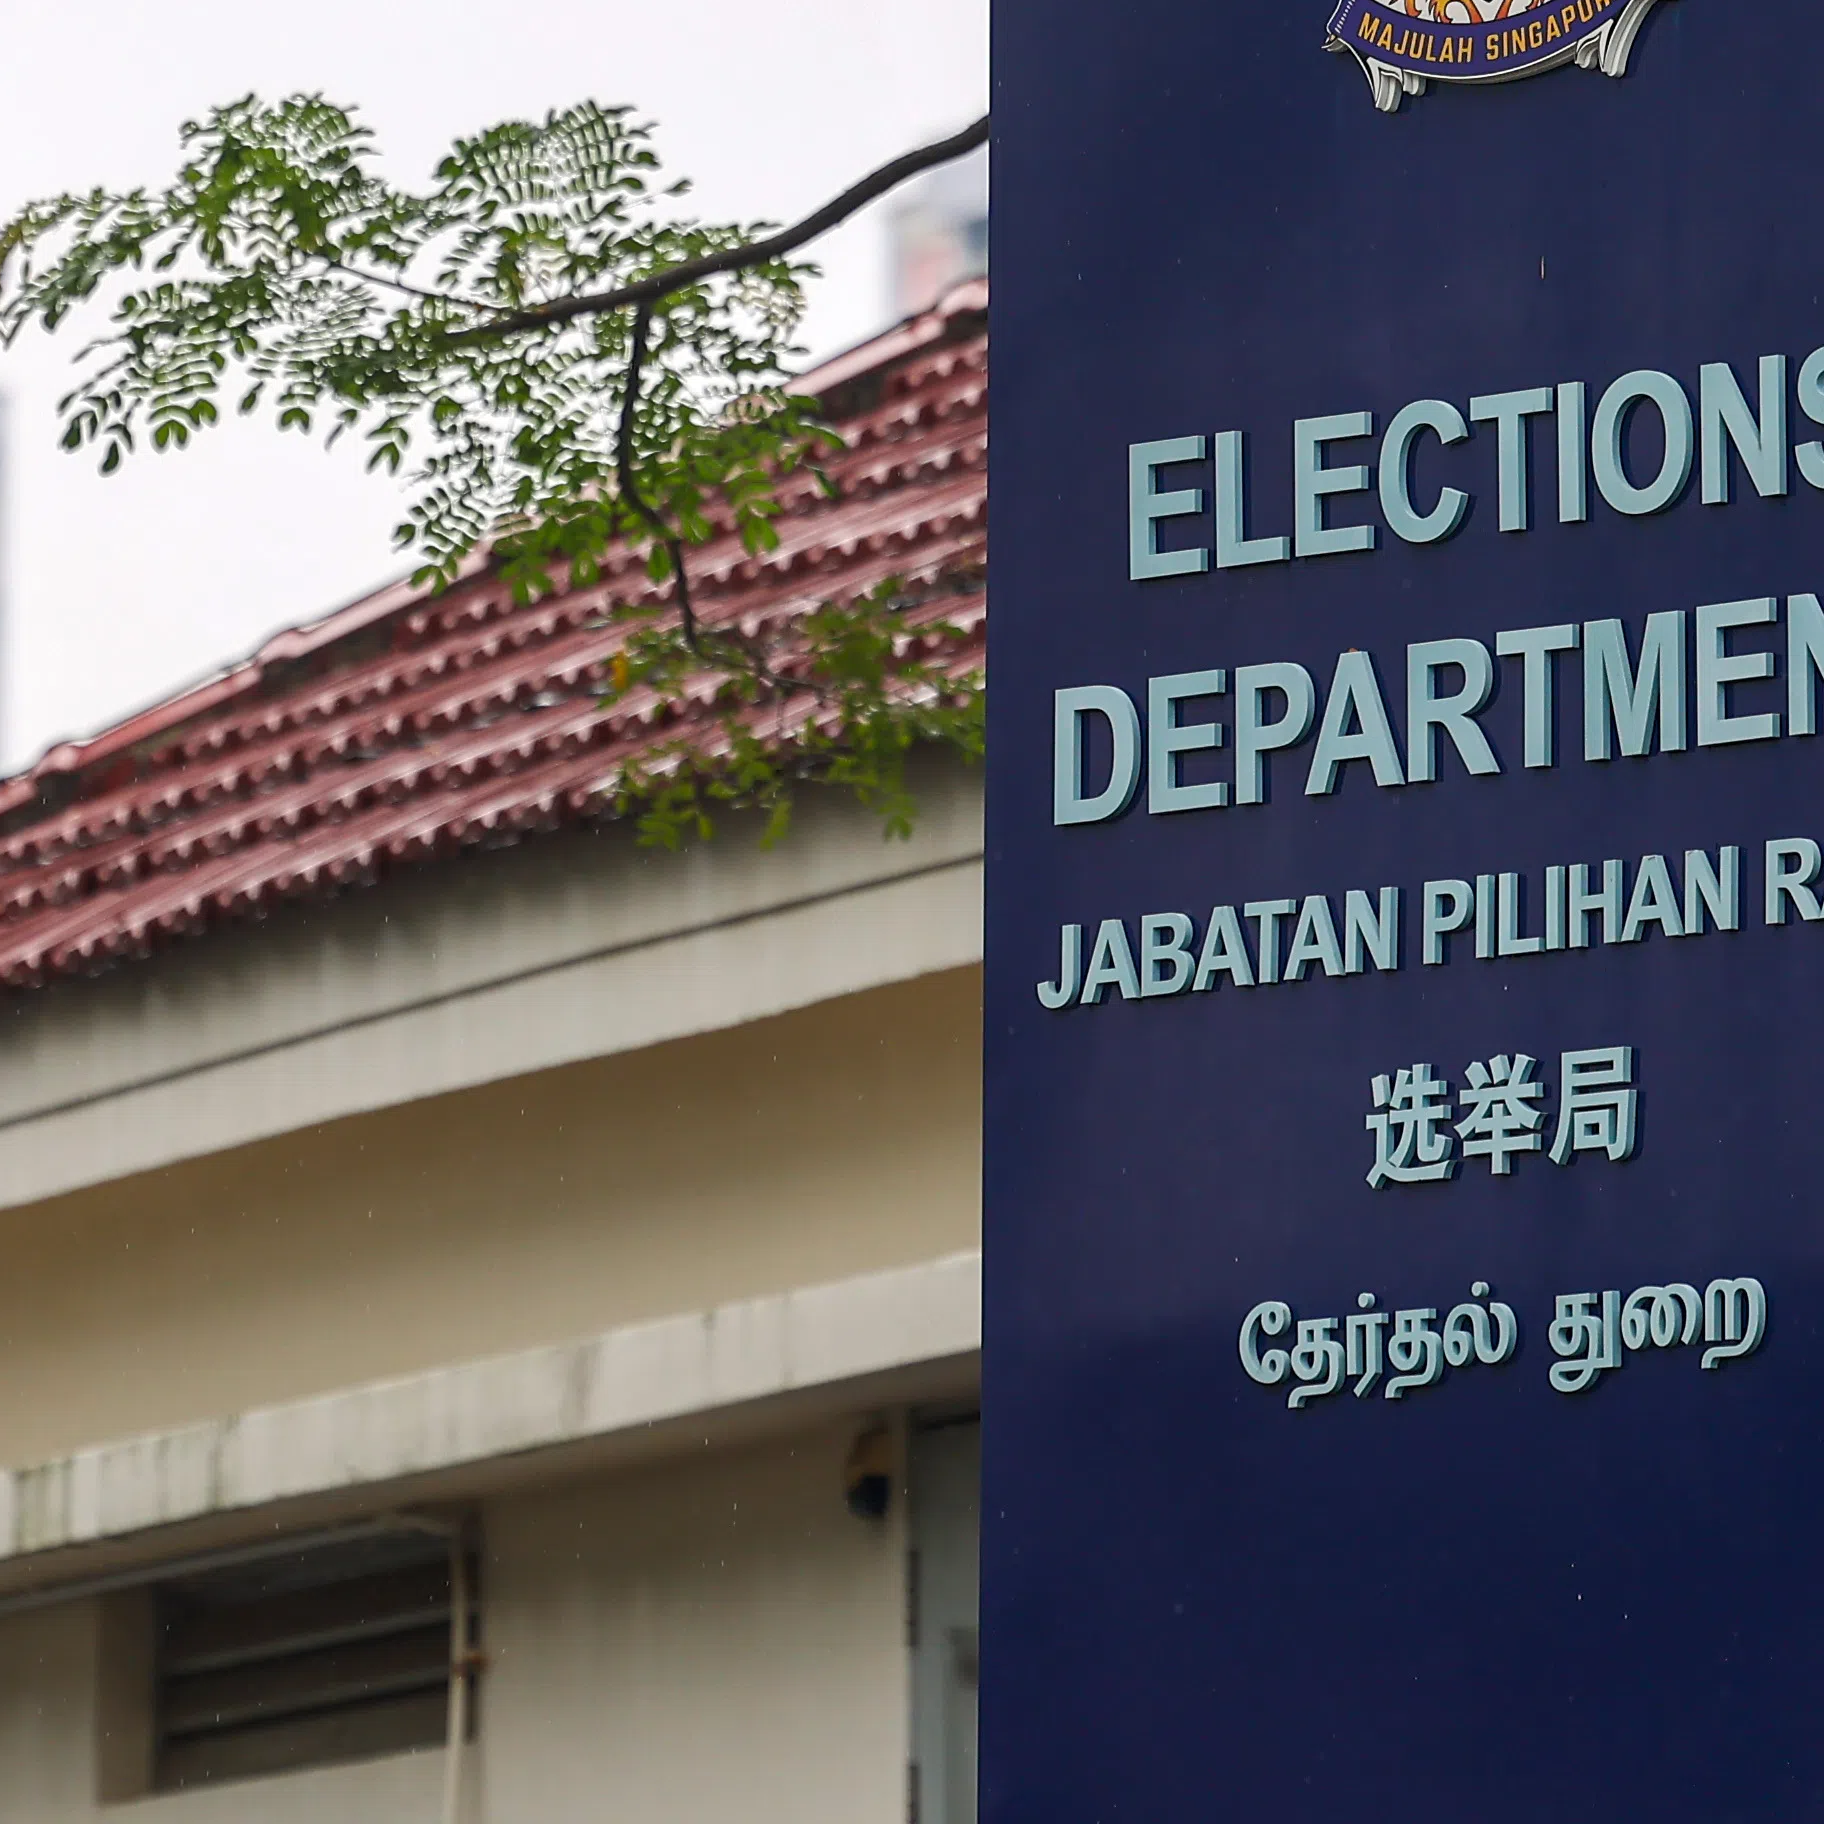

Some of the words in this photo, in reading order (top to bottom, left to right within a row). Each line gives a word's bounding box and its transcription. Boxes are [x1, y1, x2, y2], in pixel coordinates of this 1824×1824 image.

[1358, 12, 1473, 64] MAJULAH
[1036, 885, 1399, 1011] JABATAN
[1422, 844, 1740, 966] PILIHAN
[1364, 1045, 1638, 1190] 选举局
[1238, 1280, 1517, 1410] தேர்தல்
[1547, 1275, 1766, 1394] துறை
